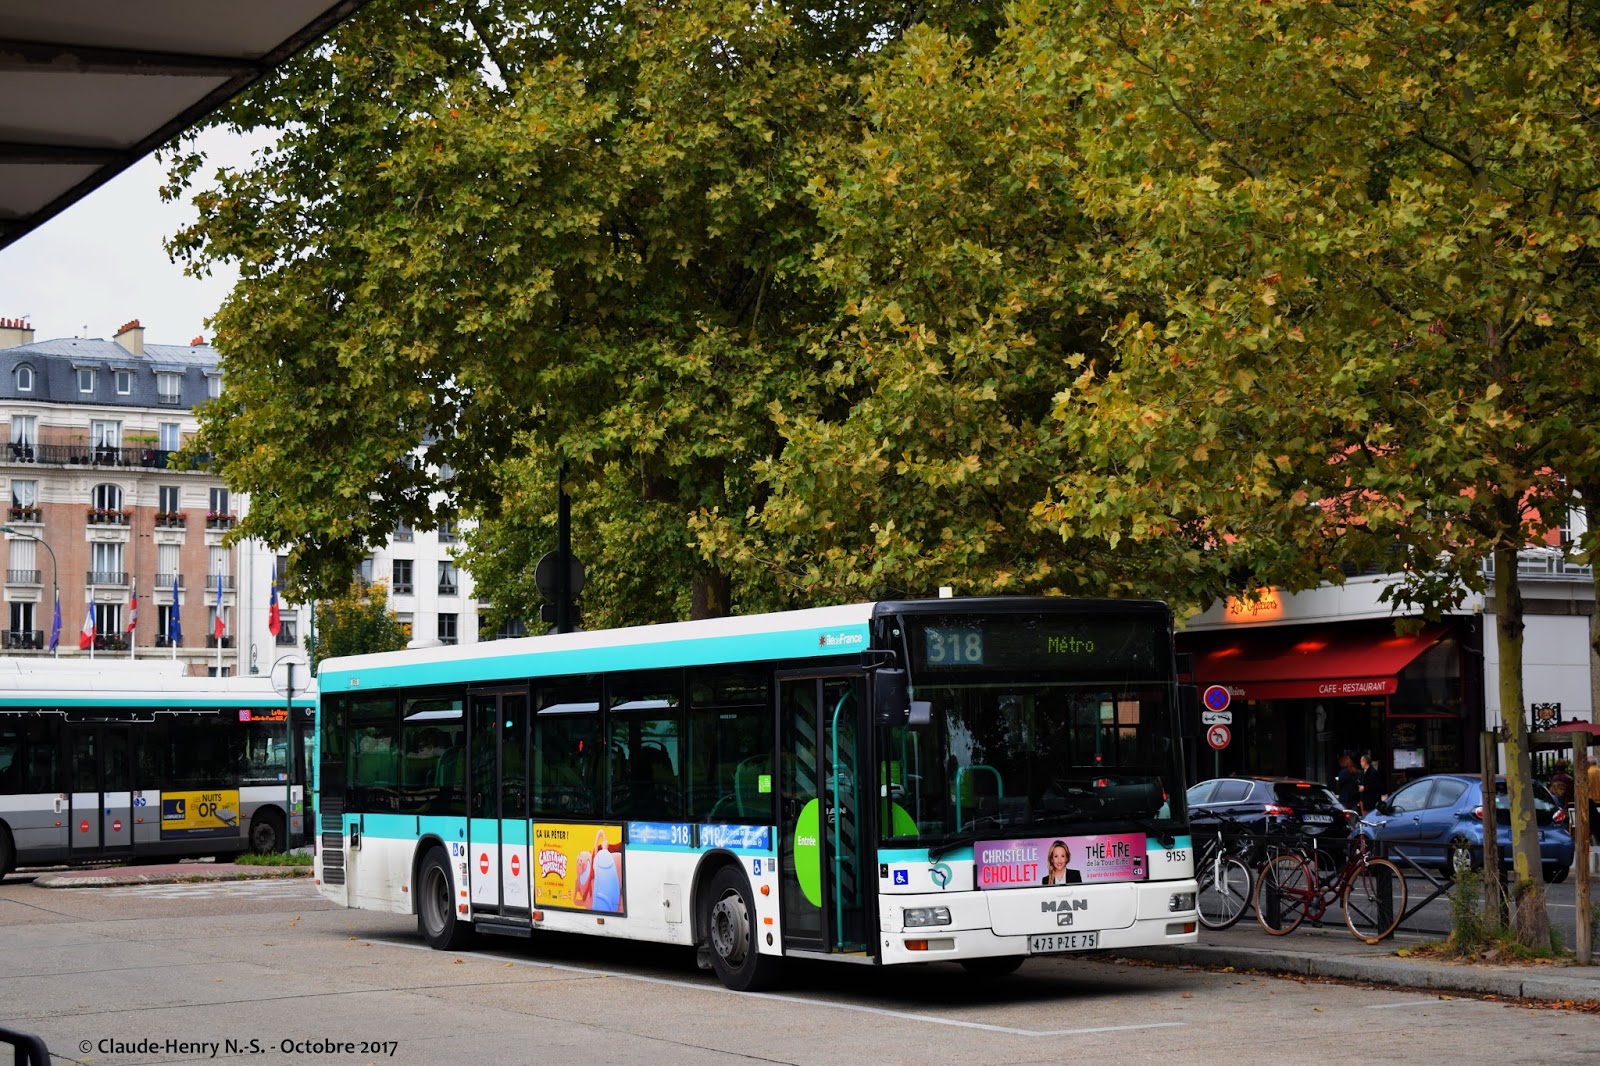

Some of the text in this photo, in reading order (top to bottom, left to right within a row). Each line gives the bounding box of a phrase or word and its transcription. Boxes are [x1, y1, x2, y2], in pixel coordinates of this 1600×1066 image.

[930, 633, 982, 662] 318
[1049, 636, 1094, 653] Métro
[1319, 684, 1337, 694] CAFE
[1343, 681, 1386, 693] RESTAURANT
[202, 794, 222, 802] NUITS
[198, 802, 217, 818] OR
[543, 829, 550, 839] VA
[671, 825, 689, 844] 318
[702, 826, 720, 847] 318
[797, 835, 816, 846] Entrée
[982, 848, 1038, 864] CHRISTELLE
[1116, 858, 1131, 866] Eiffel
[1166, 851, 1186, 862] 9155
[983, 864, 1038, 884] CHOLLET
[1041, 899, 1088, 912] MAN
[1033, 934, 1095, 950] 473 PZE 75
